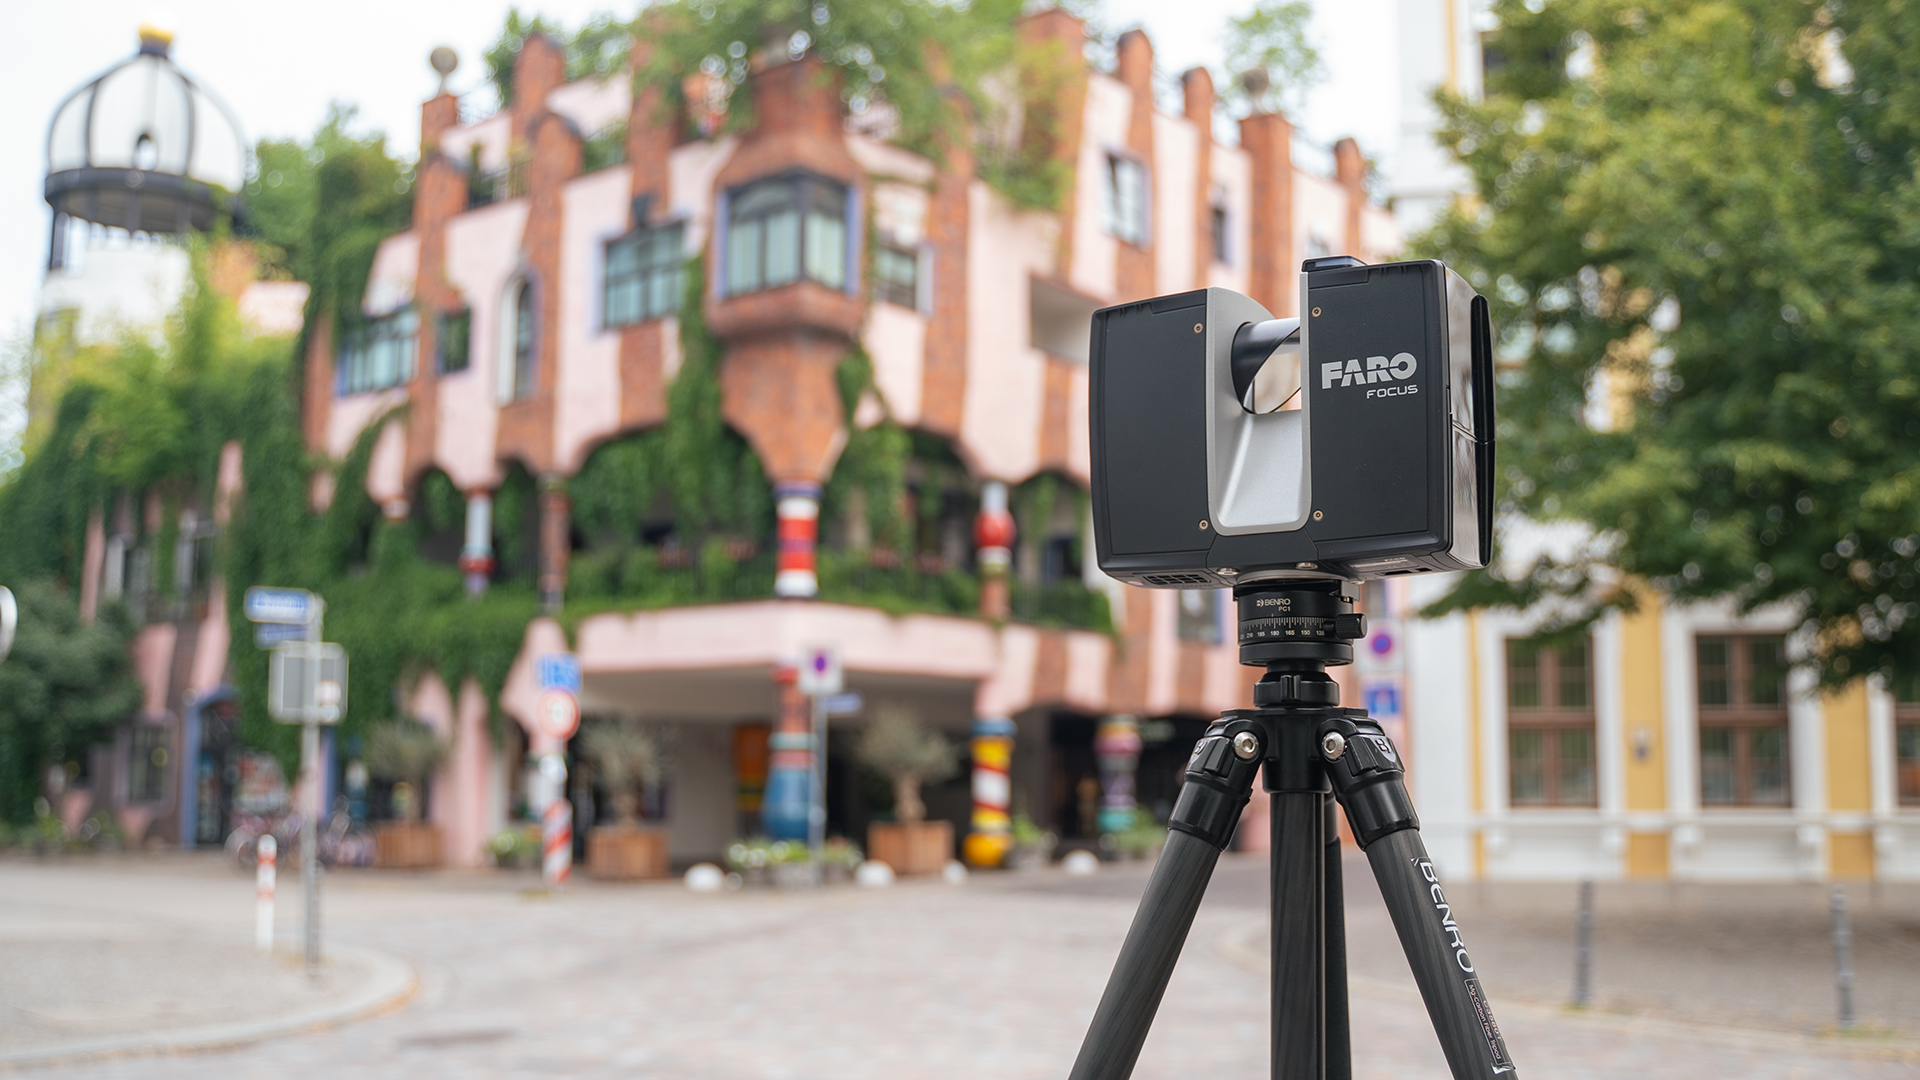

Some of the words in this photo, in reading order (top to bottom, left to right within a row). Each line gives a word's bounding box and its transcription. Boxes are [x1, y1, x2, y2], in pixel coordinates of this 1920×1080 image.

[1321, 352, 1417, 389] FARO
[1366, 384, 1418, 399] FOCUS
[1264, 598, 1291, 606] BENRO
[1420, 862, 1474, 973] BENRO
